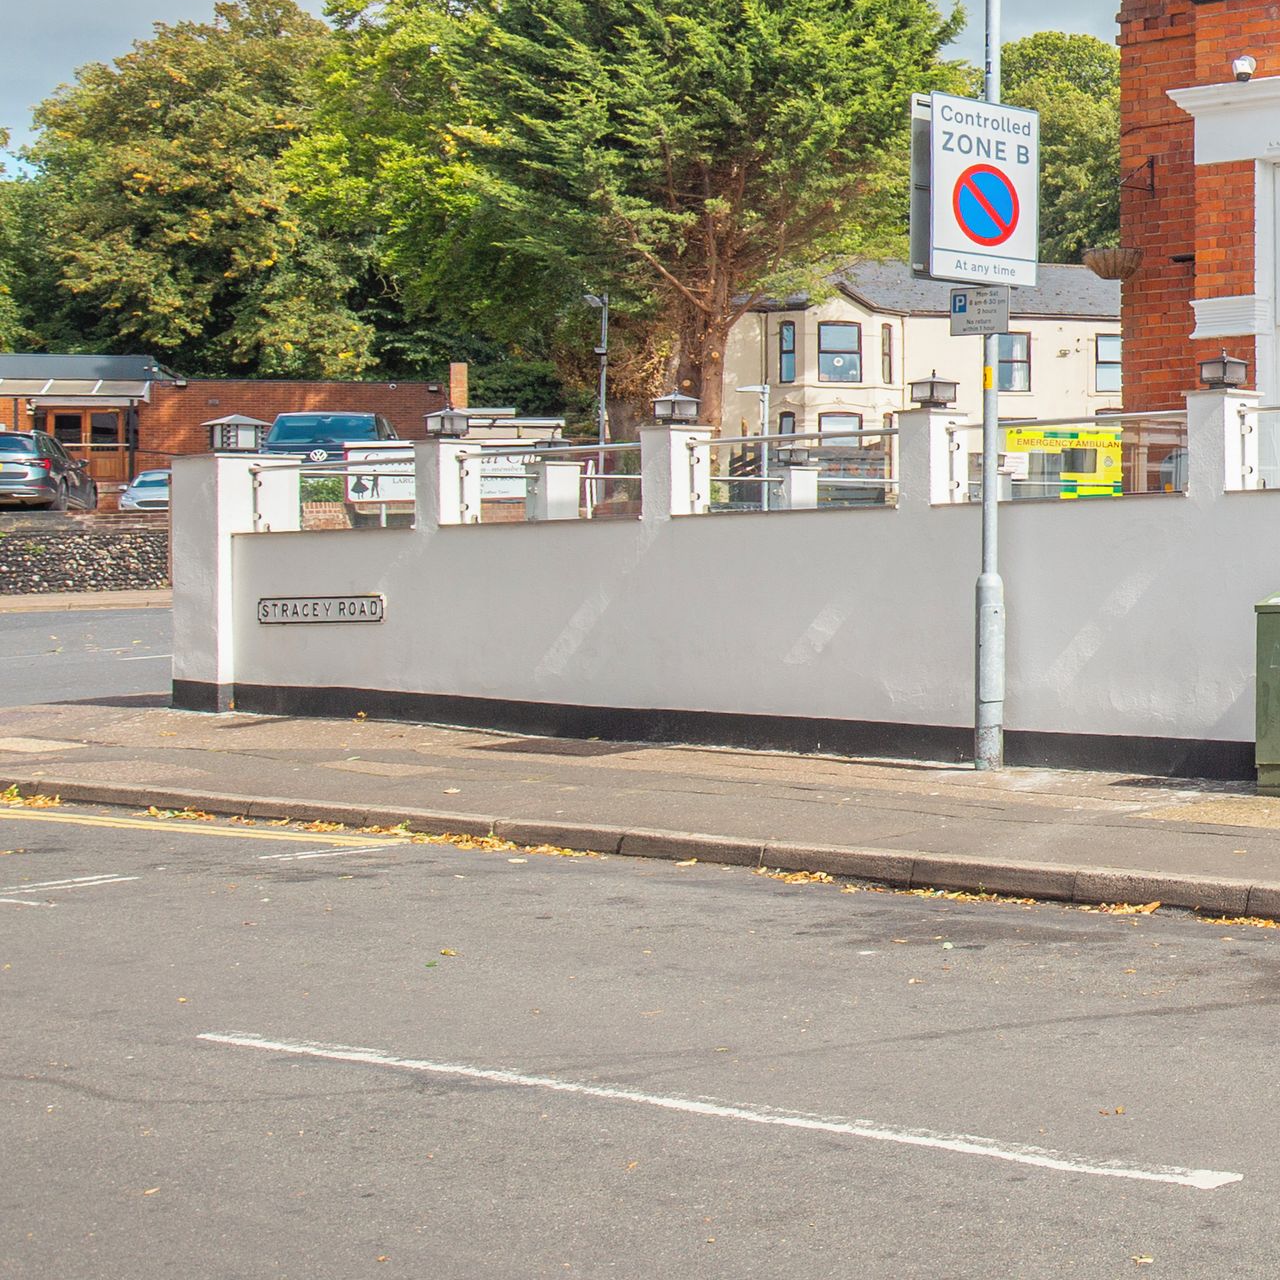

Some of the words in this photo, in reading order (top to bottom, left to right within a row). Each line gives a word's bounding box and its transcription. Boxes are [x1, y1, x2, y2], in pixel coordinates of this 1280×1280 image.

[940, 105, 1031, 137] Controlled
[942, 131, 1007, 162] ZONE
[1016, 144, 1030, 165] B
[955, 259, 969, 271] At
[970, 262, 990, 276] any
[992, 264, 1016, 277] time
[1017, 439, 1073, 447] EMERGENCY
[1075, 440, 1120, 448] AMBULAN
[262, 602, 332, 617] STRACEY
[339, 601, 378, 616] ROAD
